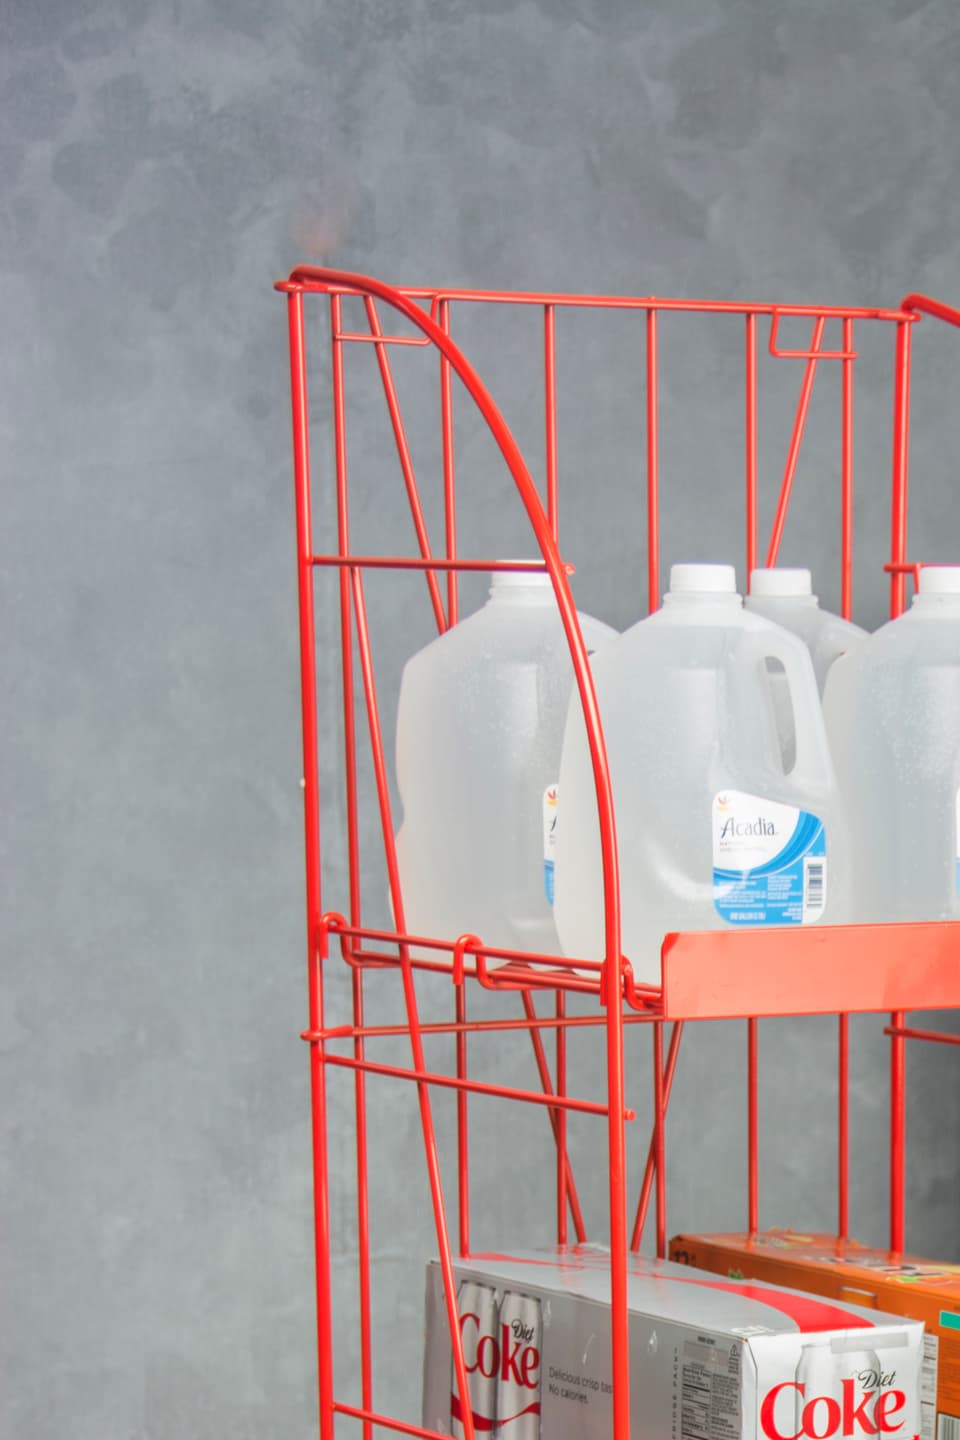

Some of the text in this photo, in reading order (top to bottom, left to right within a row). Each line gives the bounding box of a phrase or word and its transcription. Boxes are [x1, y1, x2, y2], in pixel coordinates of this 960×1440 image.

[720, 816, 775, 838] Acadia
[511, 1318, 535, 1343] Diet
[459, 1312, 540, 1390] Coke
[858, 1369, 897, 1390] Diet
